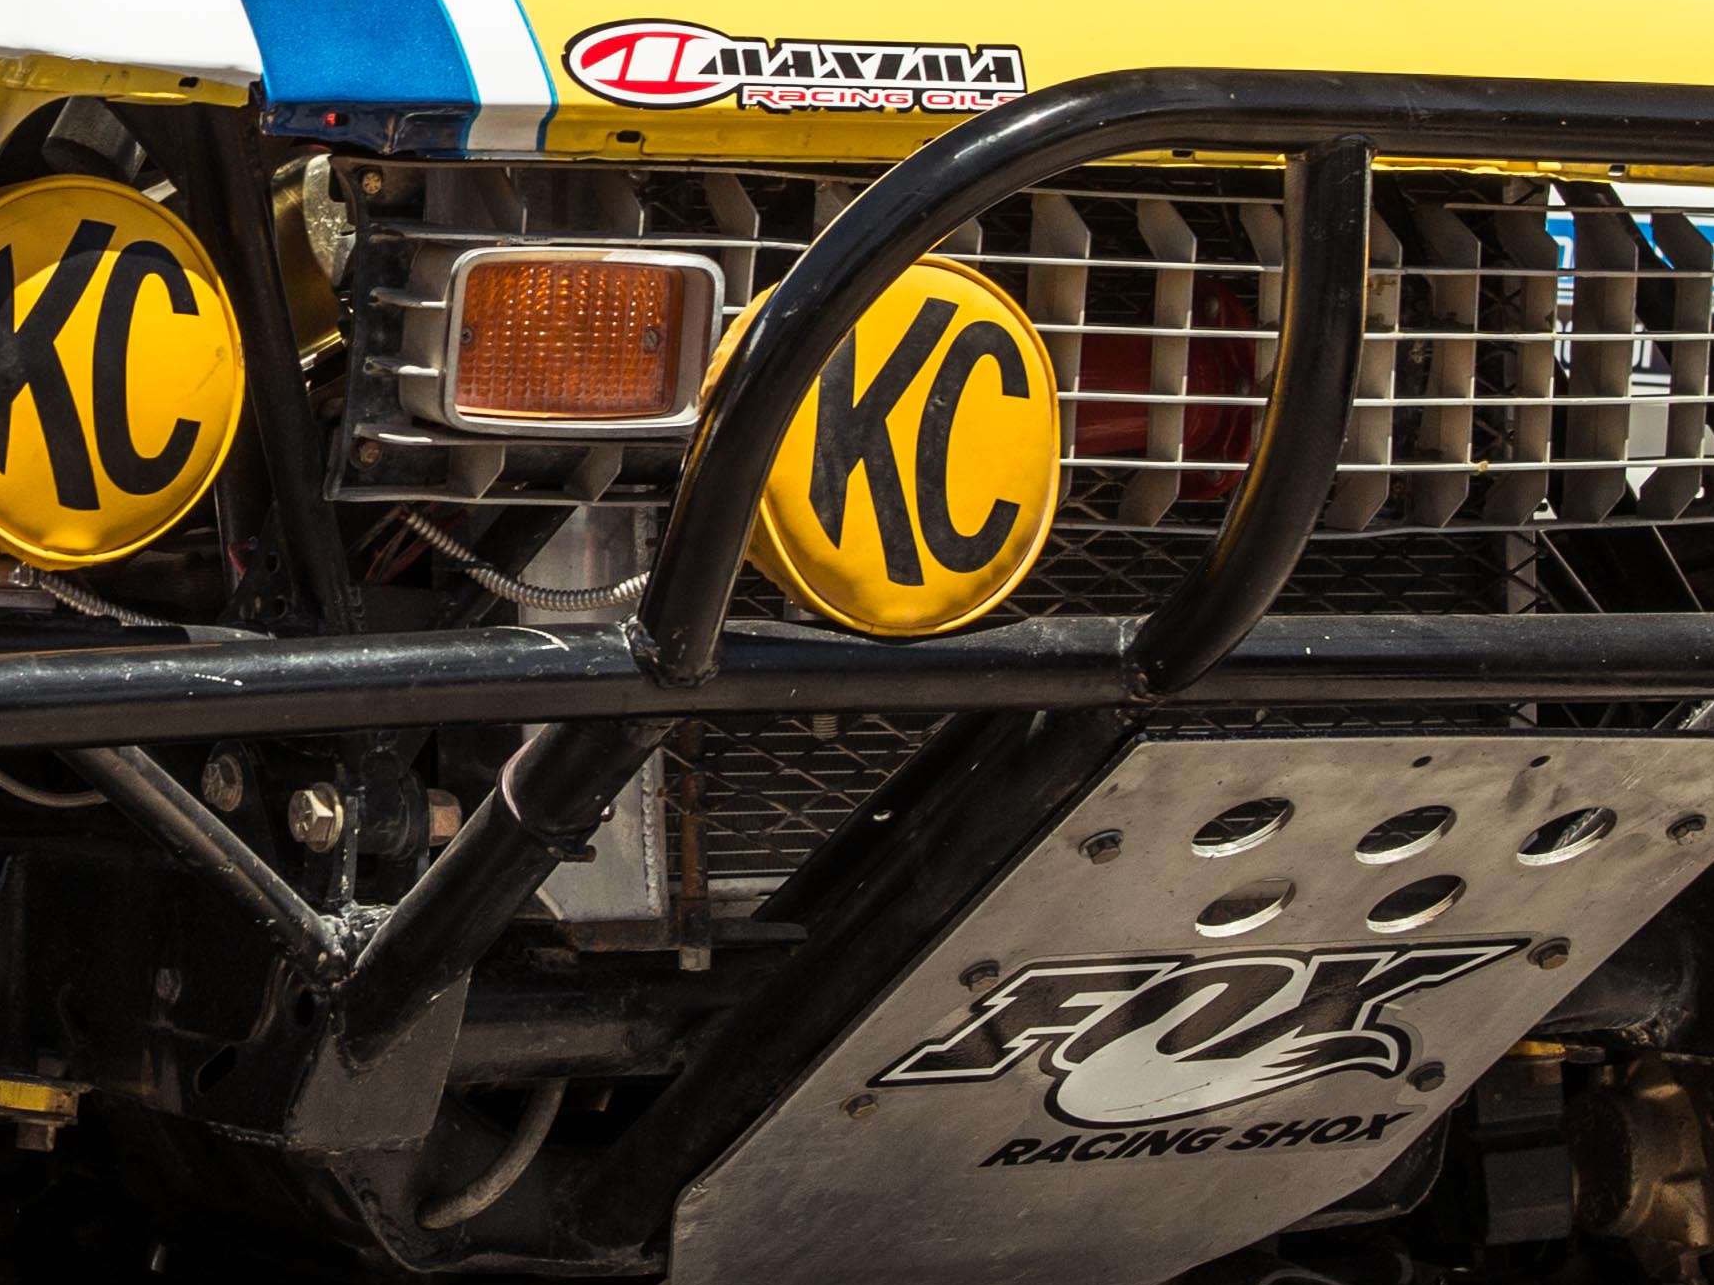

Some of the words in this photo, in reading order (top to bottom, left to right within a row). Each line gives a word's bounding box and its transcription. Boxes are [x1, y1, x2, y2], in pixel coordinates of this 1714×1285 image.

[702, 44, 1022, 86] MAXIMA
[744, 88, 911, 109] RACING
[809, 296, 1031, 588] KC
[871, 939, 1529, 1125] FOX
[978, 1125, 1229, 1169] RACING
[1224, 1112, 1414, 1152] SHOX
